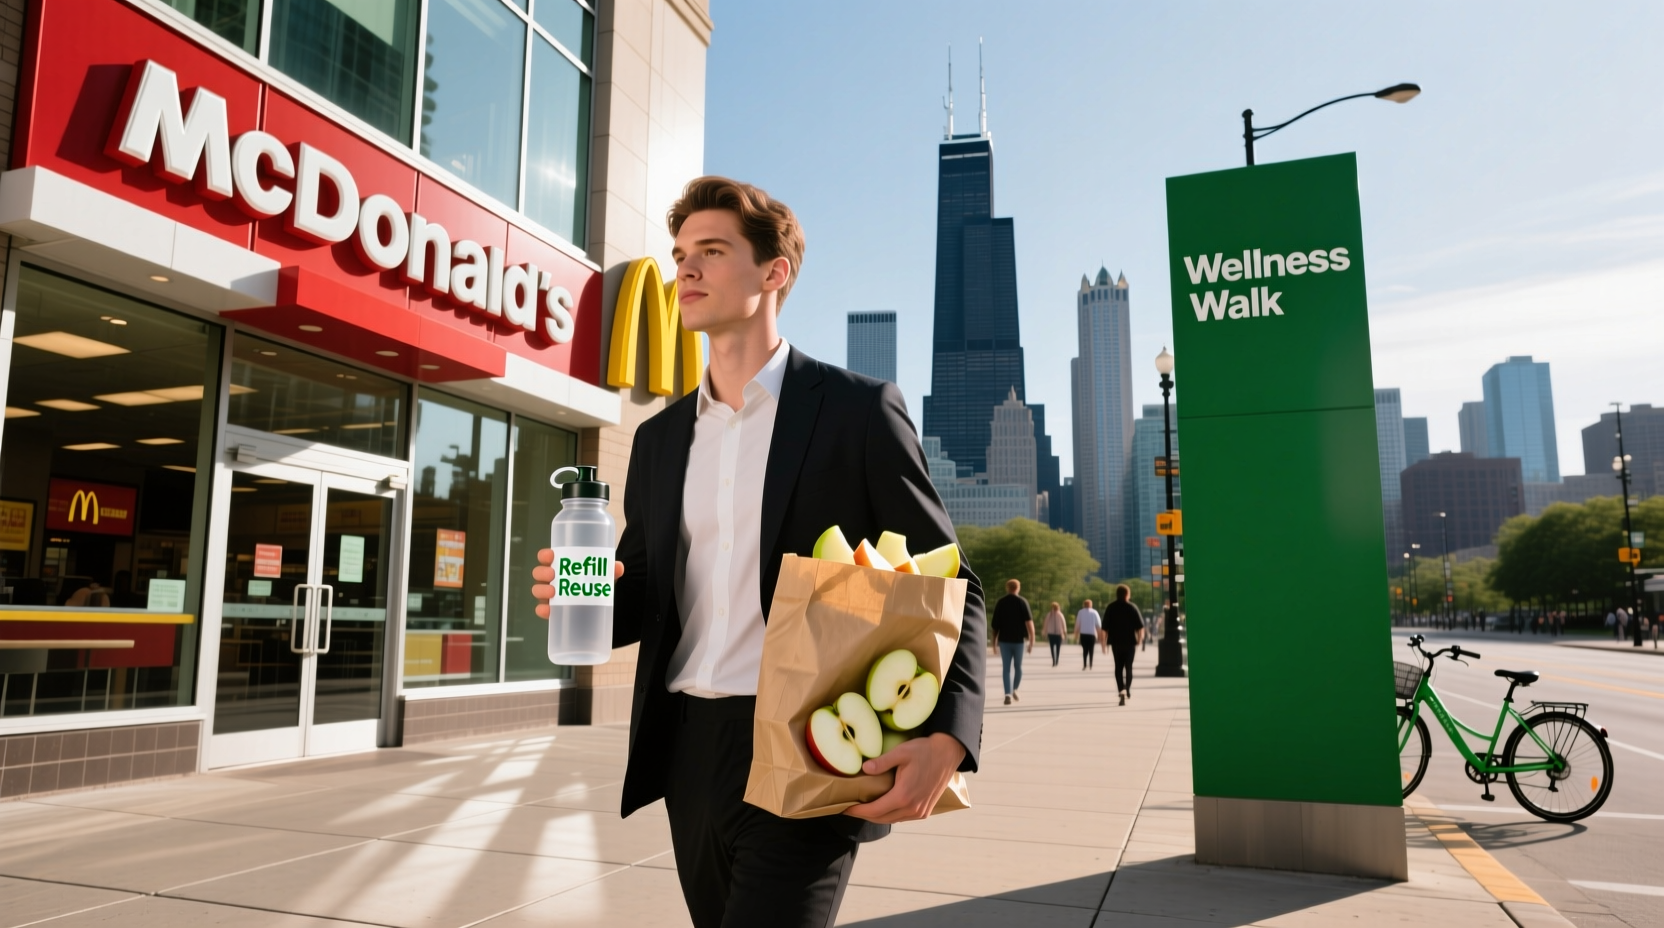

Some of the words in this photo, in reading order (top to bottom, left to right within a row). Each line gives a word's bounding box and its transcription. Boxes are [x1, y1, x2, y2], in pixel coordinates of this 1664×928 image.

[112, 59, 575, 346] McDonald's
[1183, 247, 1351, 285] Wellness
[1189, 286, 1285, 322] Walk
[558, 556, 608, 577] Refill
[558, 578, 612, 597] Reuse
